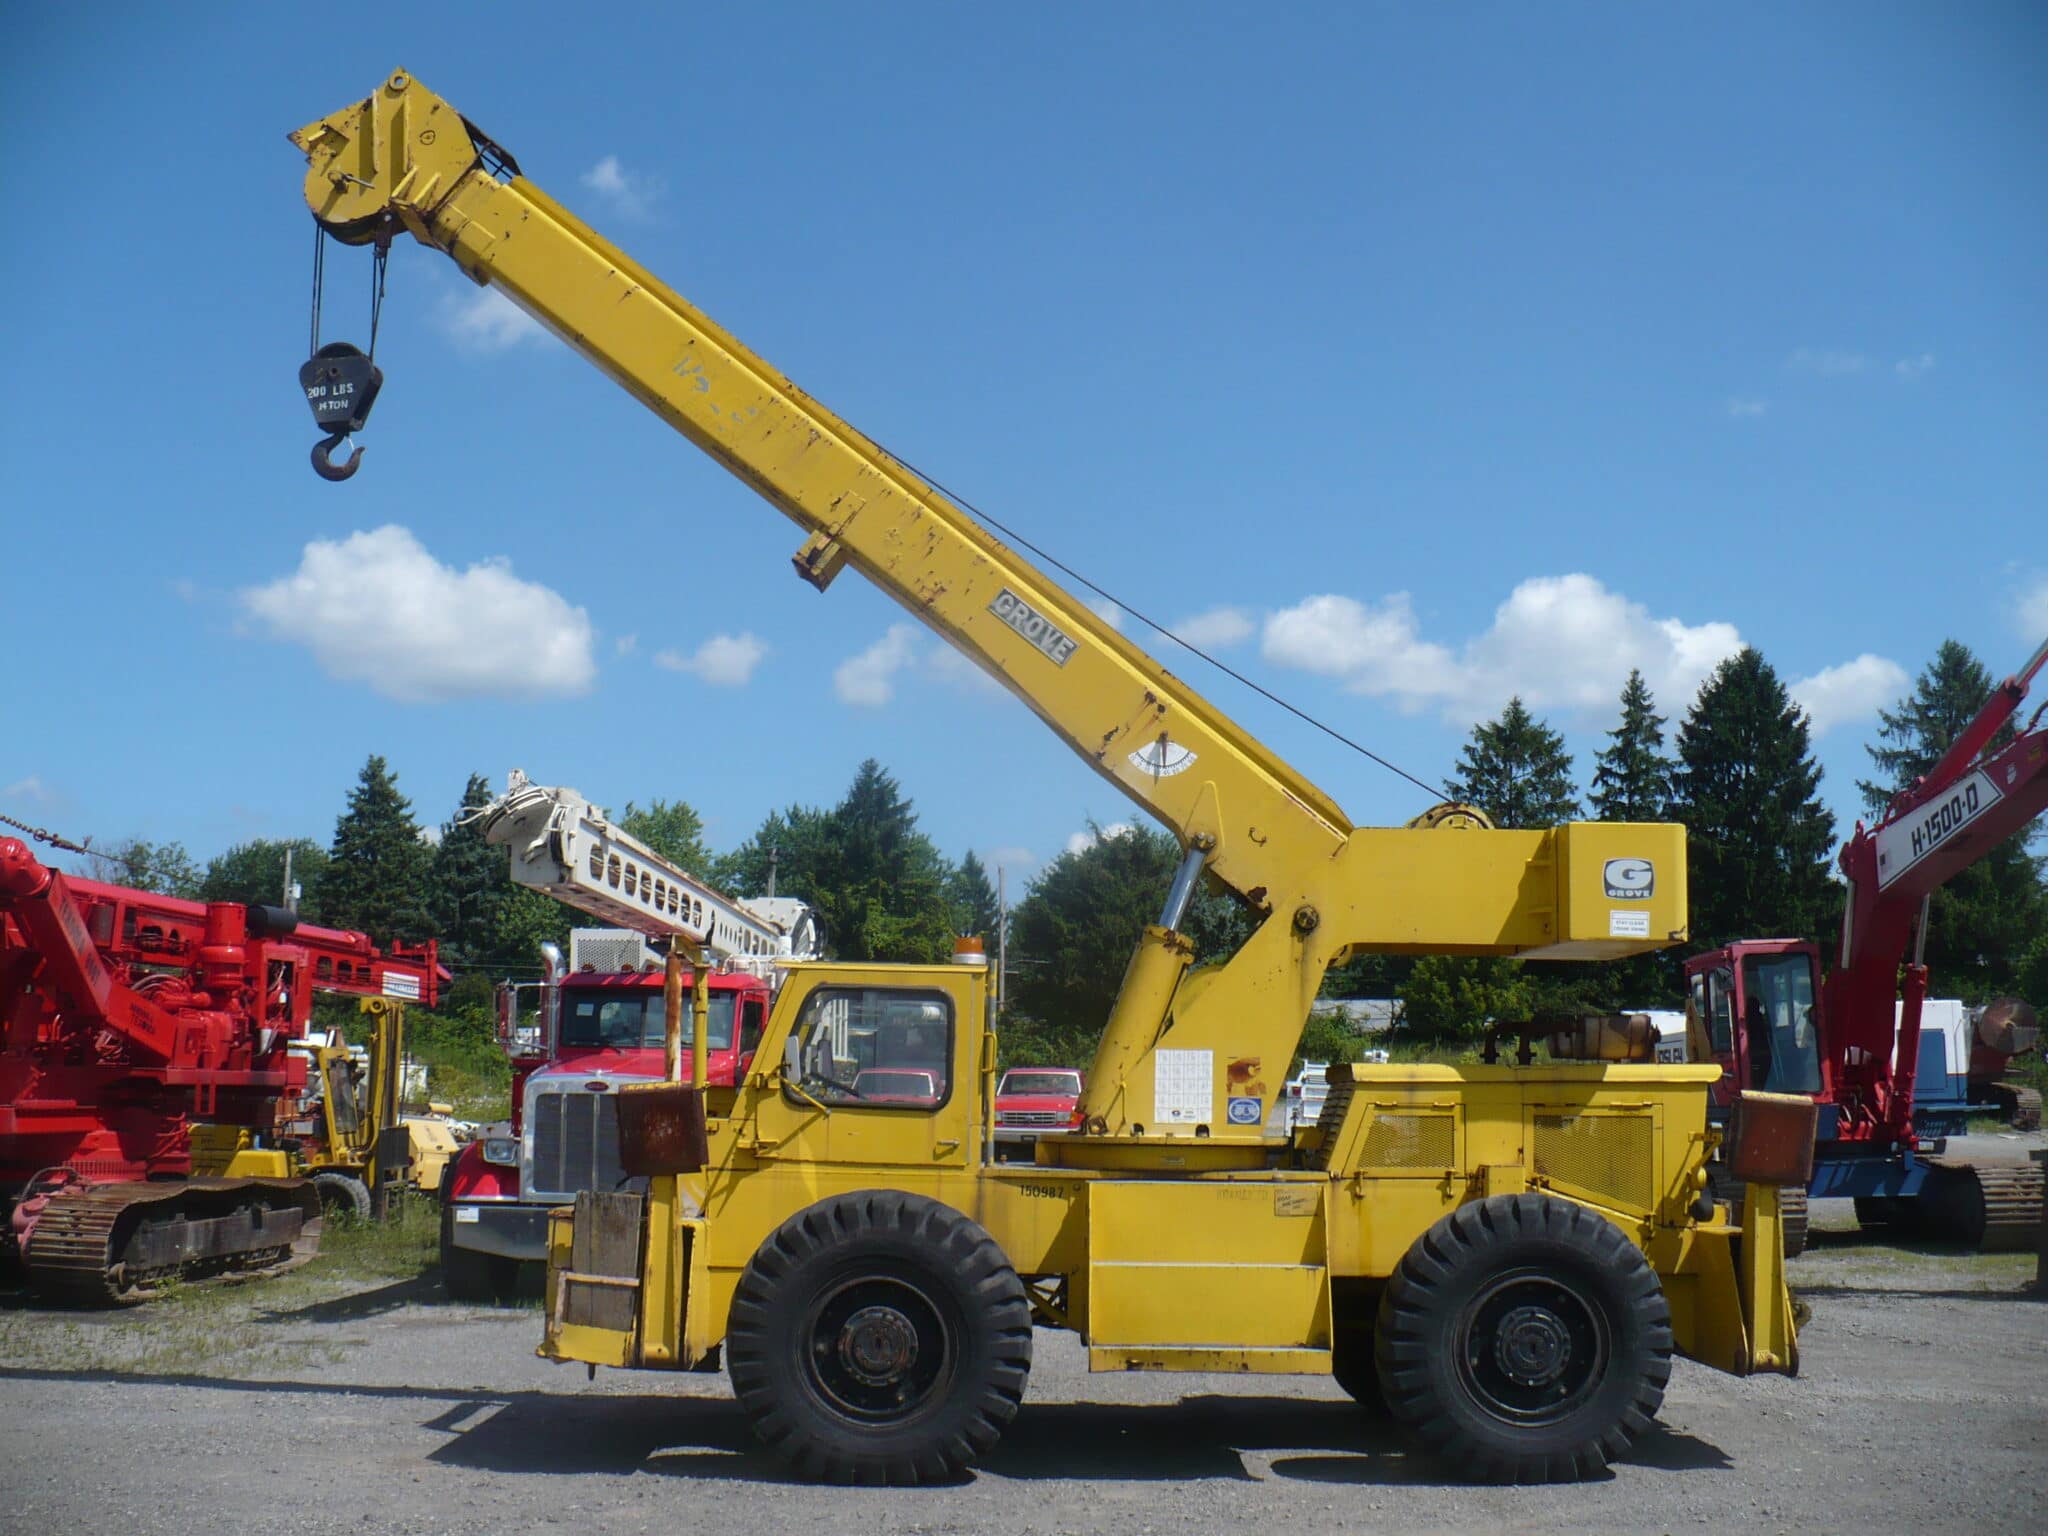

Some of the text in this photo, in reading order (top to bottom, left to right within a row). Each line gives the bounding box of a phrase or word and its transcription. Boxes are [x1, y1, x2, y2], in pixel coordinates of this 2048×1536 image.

[332, 382, 354, 396] LBS
[994, 593, 1076, 661] GROVE
[1607, 889, 1650, 898] GROVE
